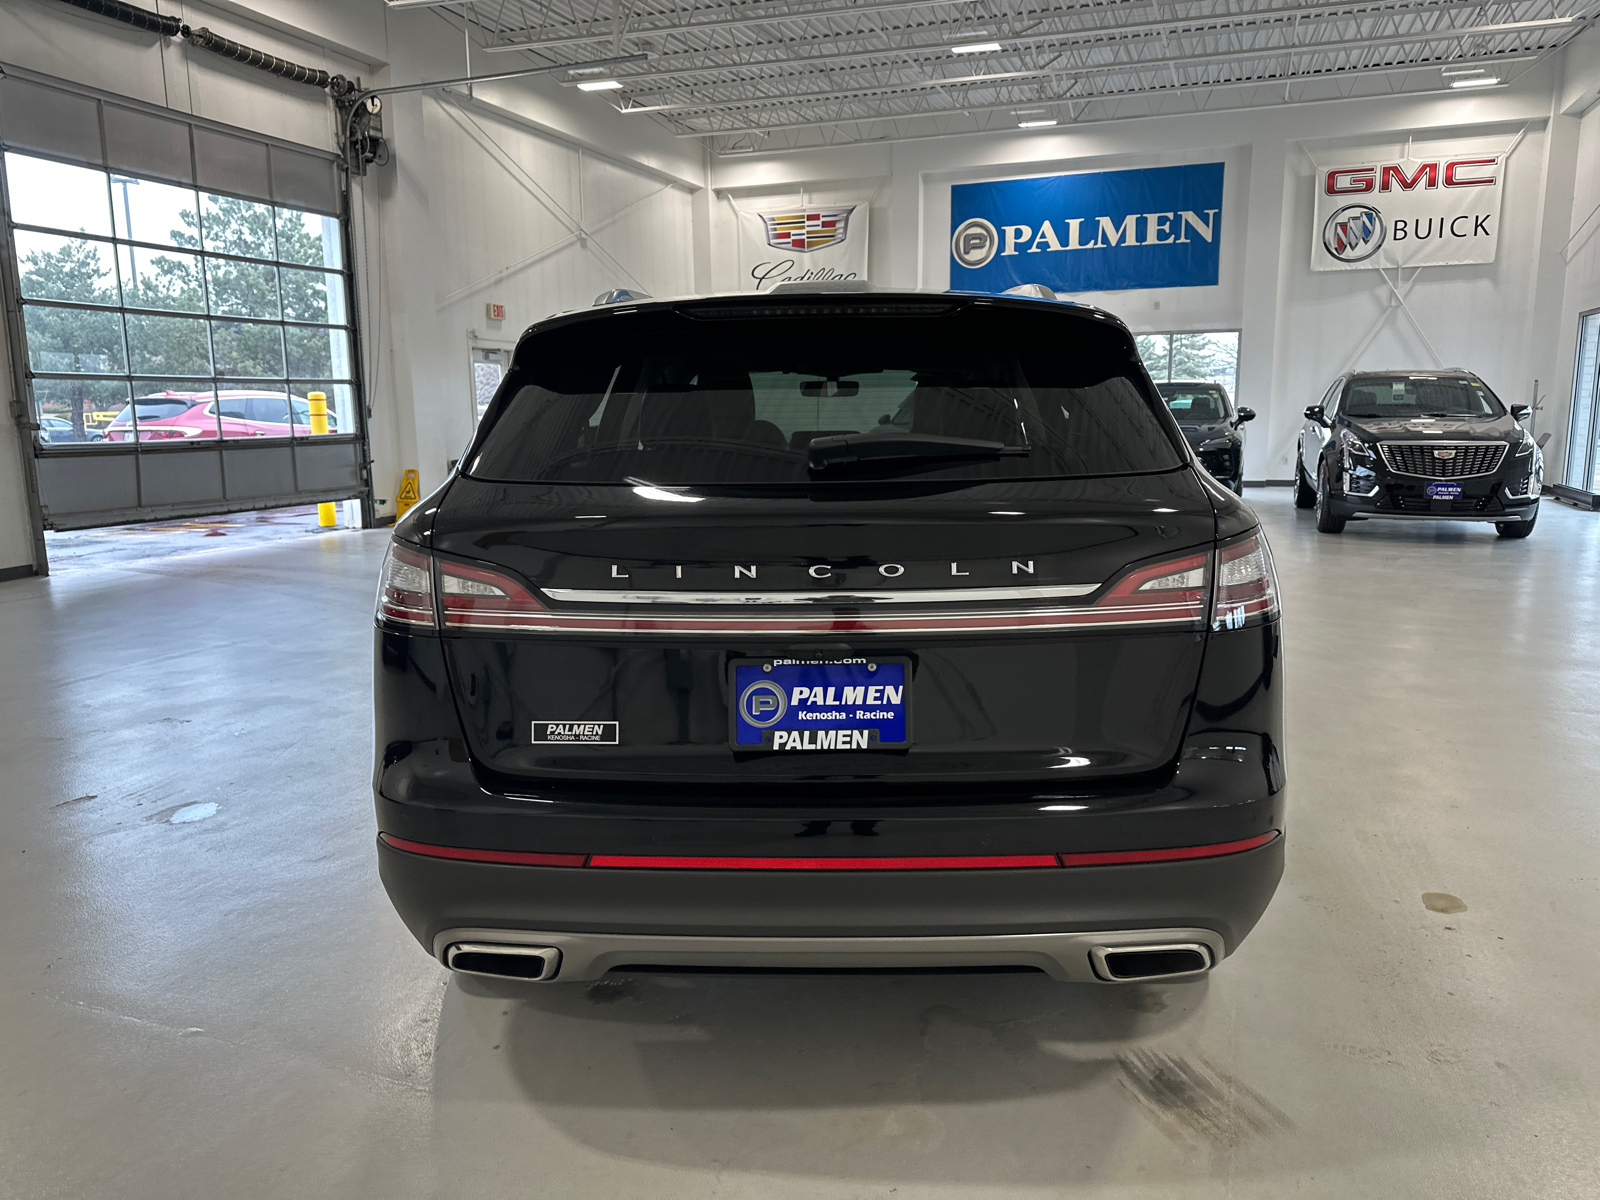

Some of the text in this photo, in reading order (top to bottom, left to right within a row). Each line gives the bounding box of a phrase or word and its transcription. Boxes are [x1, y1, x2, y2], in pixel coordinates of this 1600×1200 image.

[1325, 156, 1498, 196] GMC
[1000, 209, 1219, 256] PALMEN
[1393, 214, 1491, 241] BUICK
[611, 559, 1035, 579] LINCOLN
[790, 685, 903, 706] PALMEN
[798, 711, 846, 720] Kenosha
[856, 710, 895, 719] Racine
[546, 724, 604, 735] PALMEN
[772, 730, 869, 750] PALMEN
